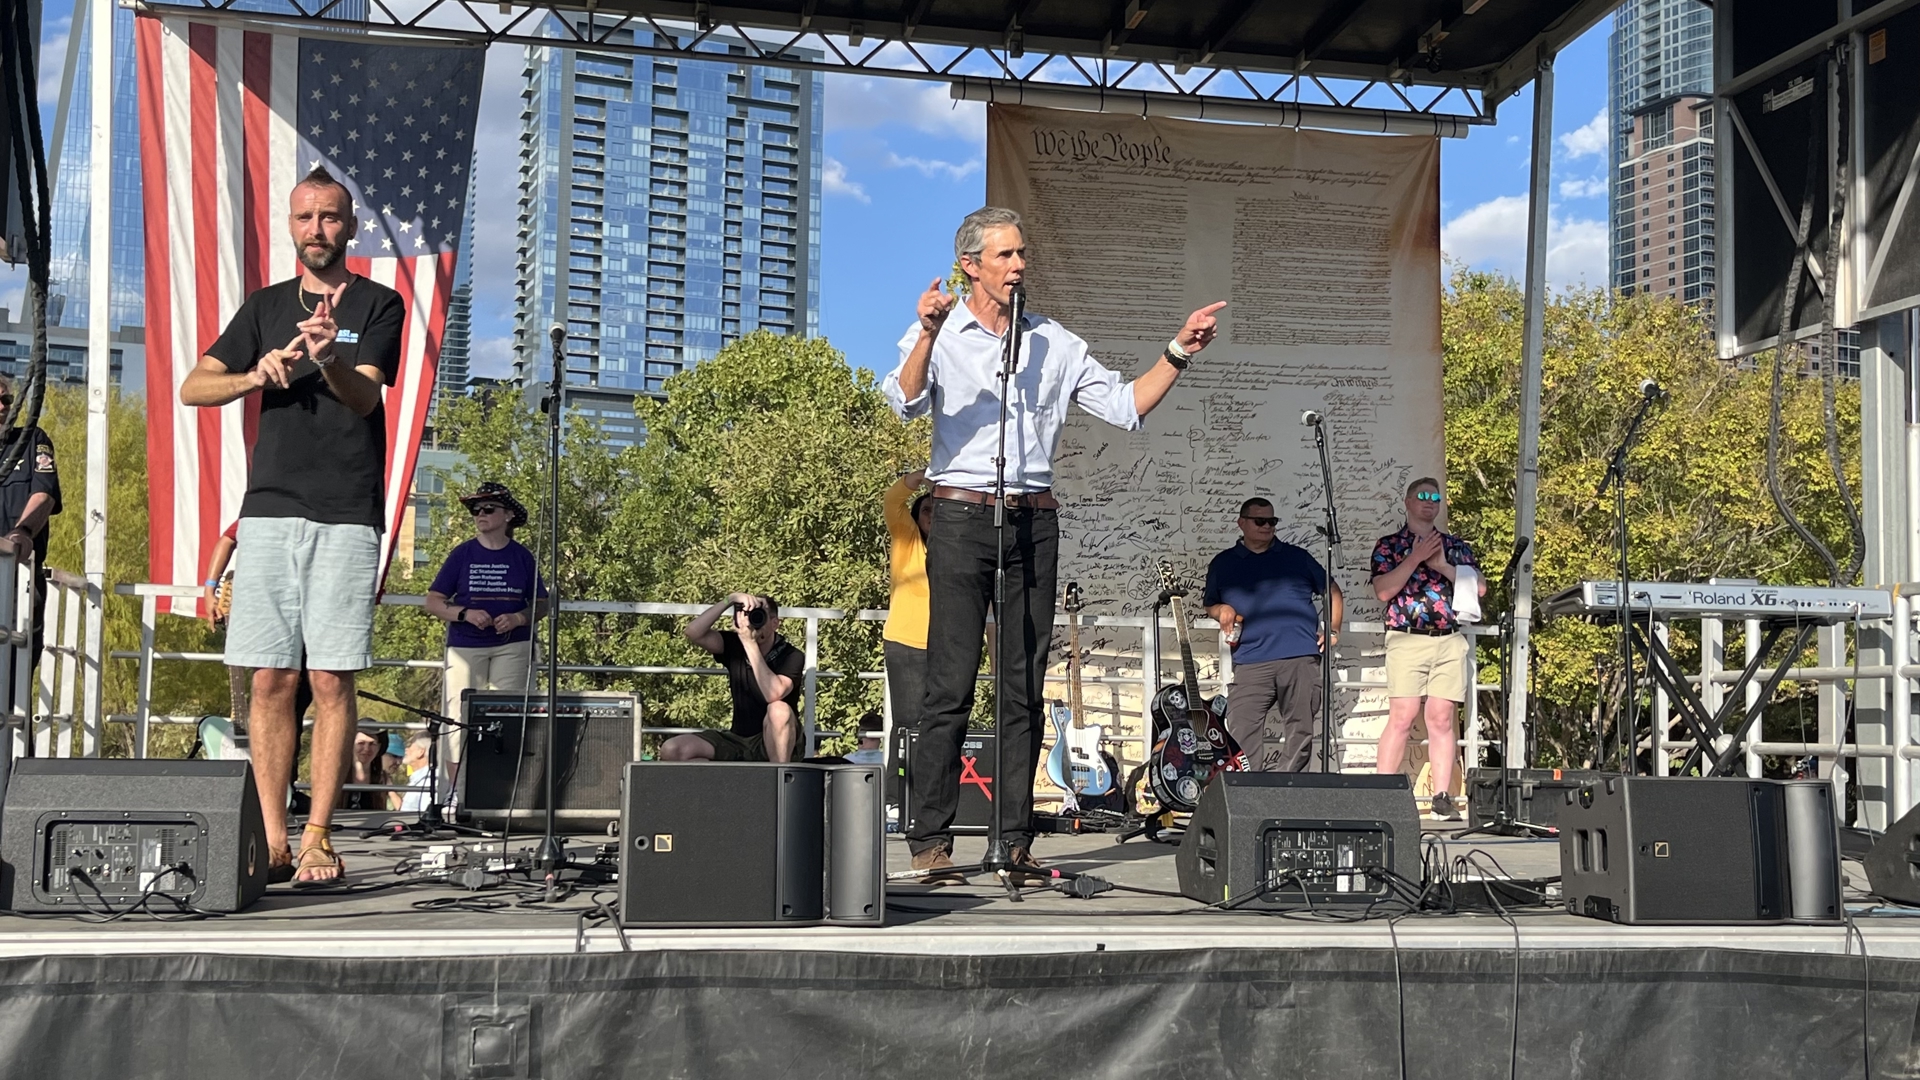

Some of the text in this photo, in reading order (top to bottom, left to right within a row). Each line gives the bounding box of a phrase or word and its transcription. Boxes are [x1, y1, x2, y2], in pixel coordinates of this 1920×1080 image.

[1030, 126, 1067, 160] We
[1100, 131, 1171, 168] People
[1088, 588, 1116, 597] NGUYEN
[1693, 591, 1778, 606] Roland X6
[962, 741, 983, 749] OSS
